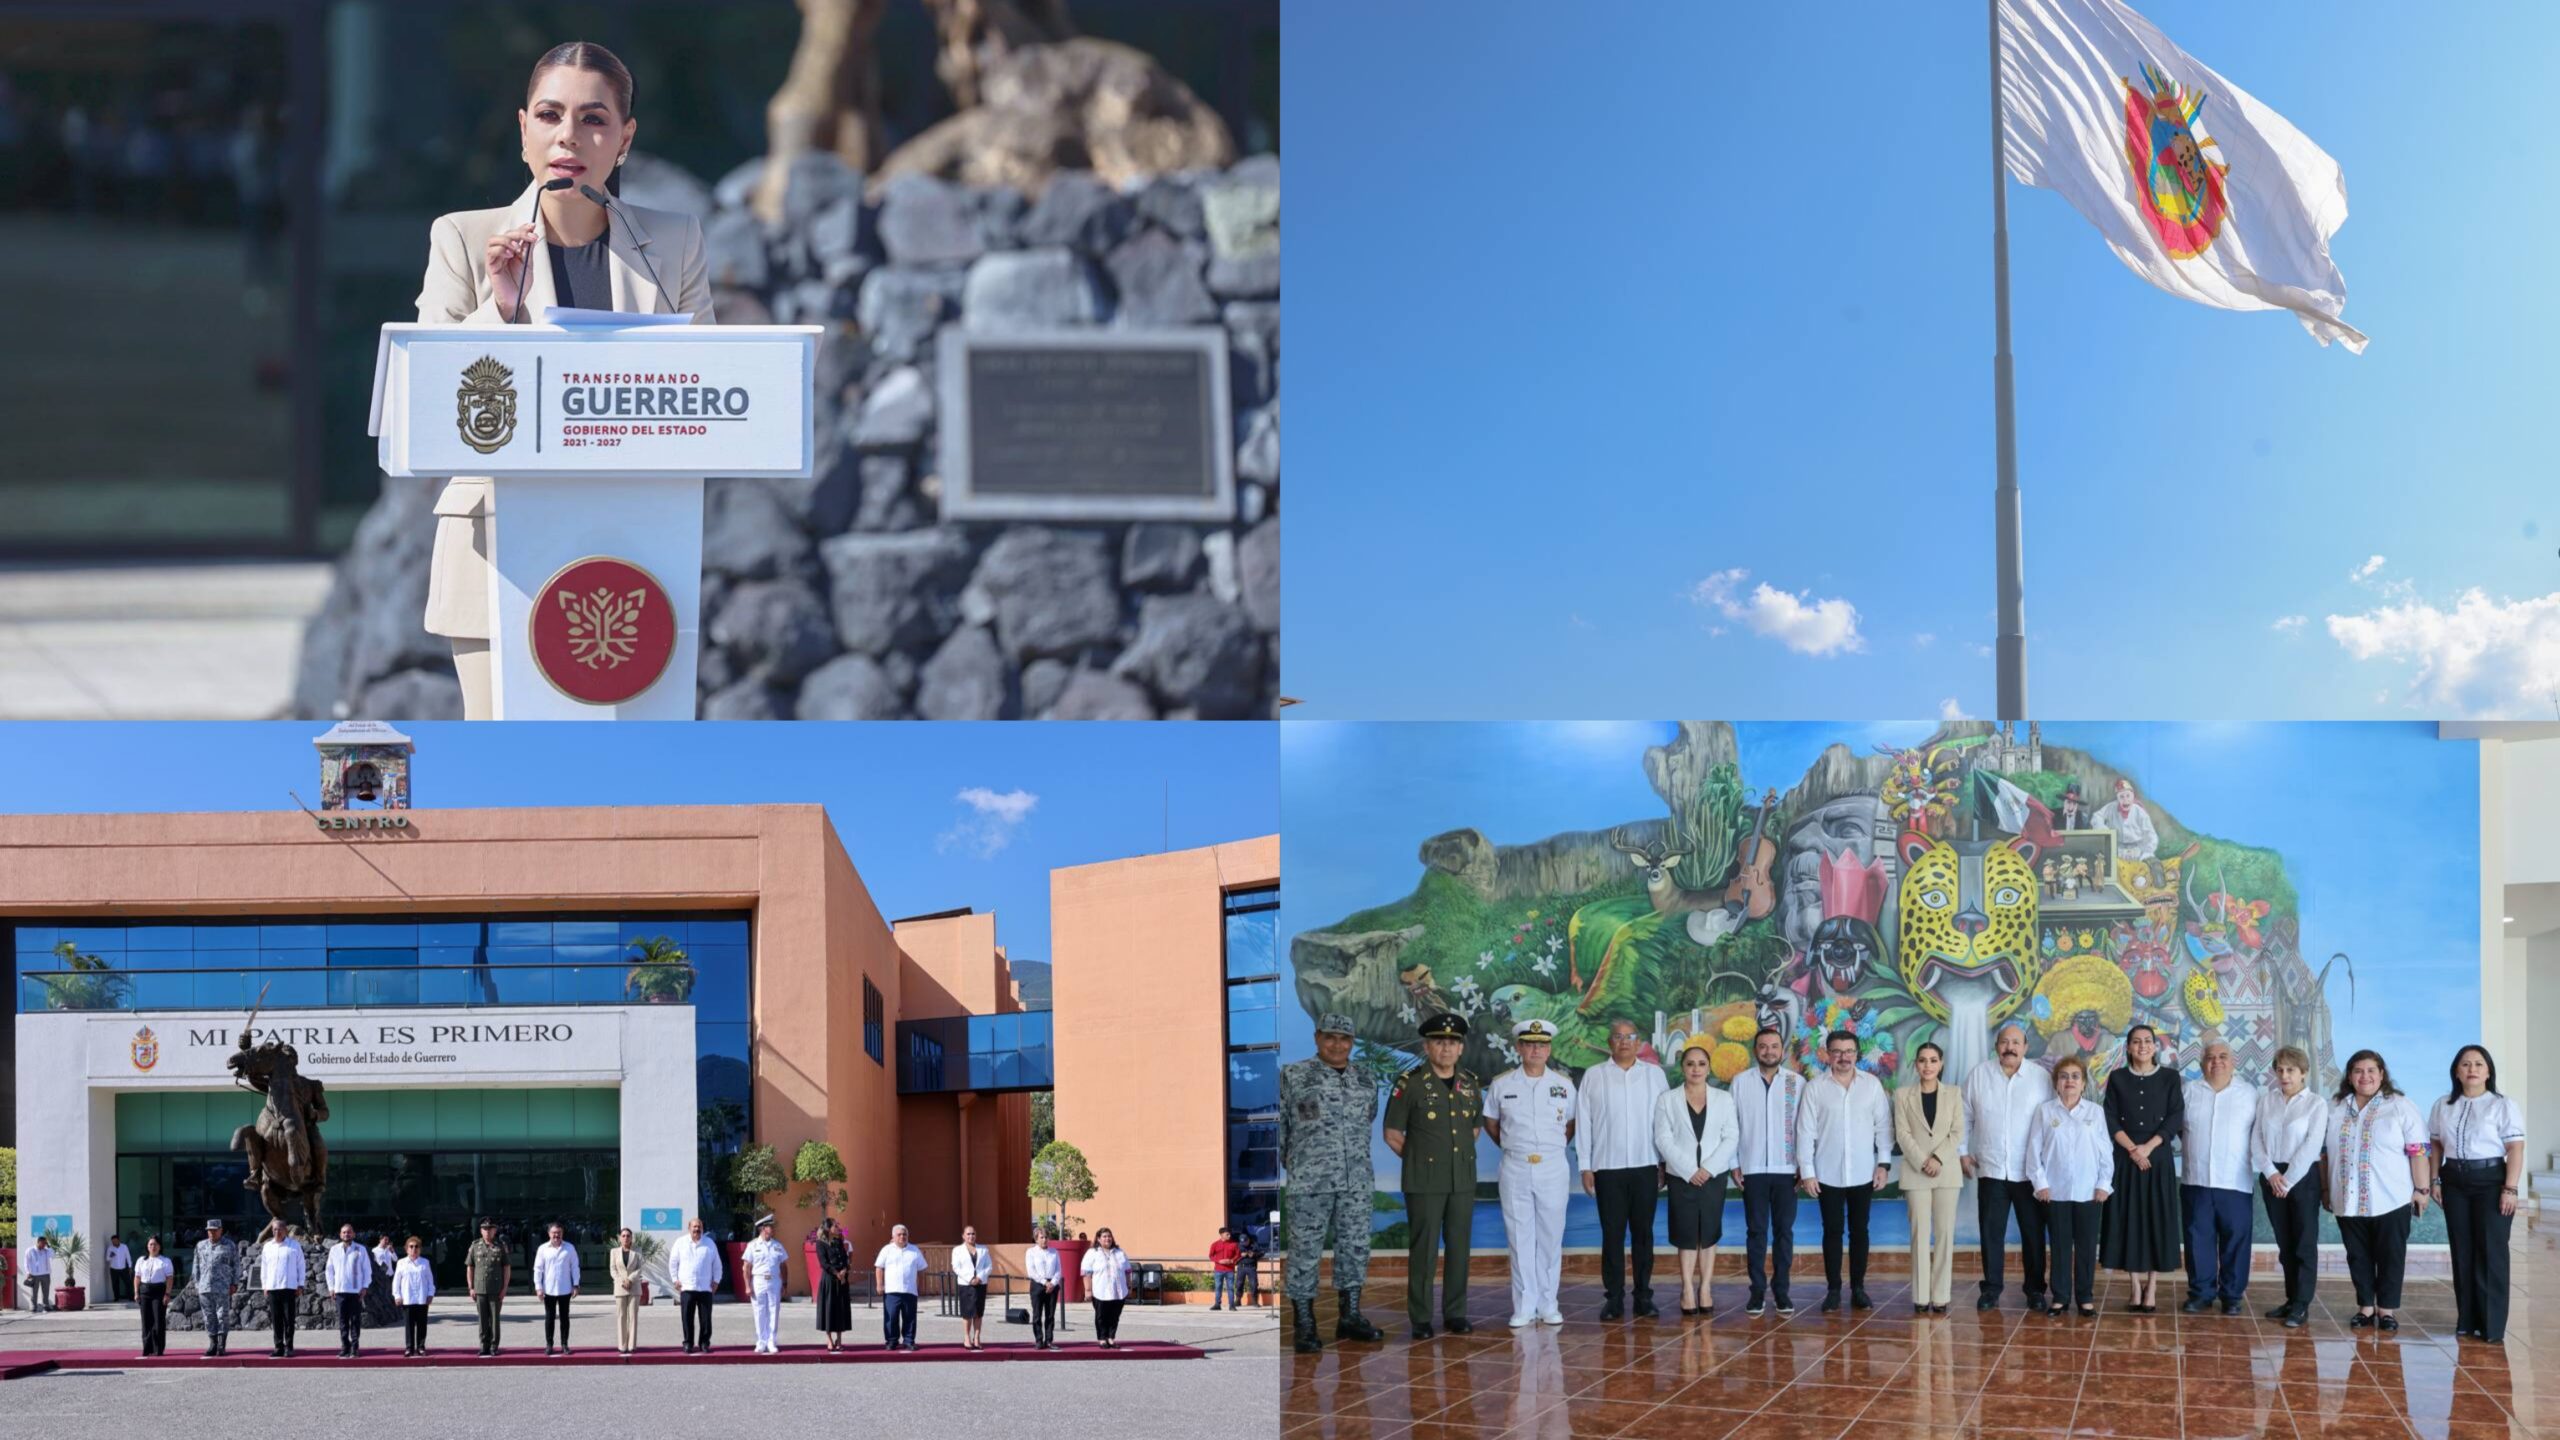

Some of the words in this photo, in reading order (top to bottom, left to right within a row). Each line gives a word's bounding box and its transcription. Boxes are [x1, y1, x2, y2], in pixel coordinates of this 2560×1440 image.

[562, 373, 700, 384] TRANSFORMANDO
[562, 387, 750, 416] GUERRERO
[563, 425, 628, 436] GOBIERNO
[631, 425, 655, 436] DEL
[658, 425, 707, 436] ESTADO
[563, 438, 587, 447] 2021
[597, 438, 622, 447] 2027
[316, 815, 409, 830] CENTRO
[188, 1028, 229, 1047] MI
[250, 1027, 361, 1045] PATRIA
[378, 1026, 416, 1045] ES
[430, 1023, 573, 1044] PRIMERO
[308, 1052, 352, 1065] Gobierno
[353, 1052, 368, 1064] del
[369, 1052, 400, 1064] Estado
[401, 1051, 413, 1063] de
[414, 1051, 457, 1063] Guerrero
